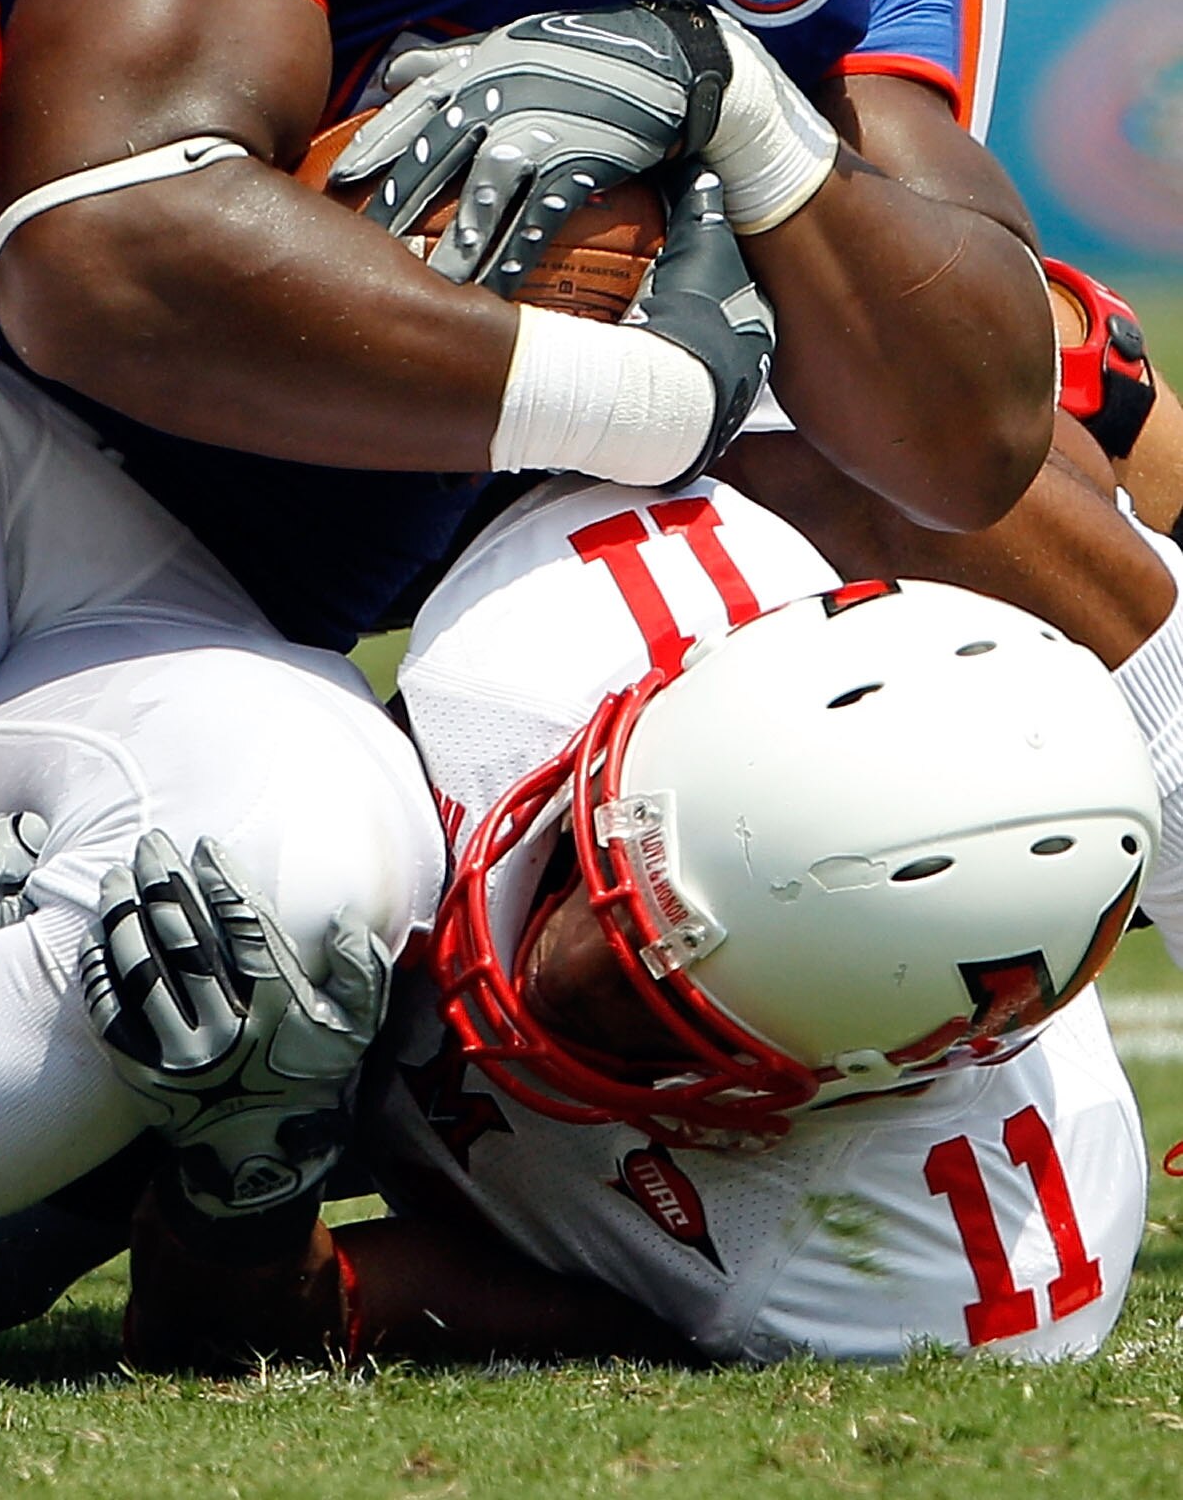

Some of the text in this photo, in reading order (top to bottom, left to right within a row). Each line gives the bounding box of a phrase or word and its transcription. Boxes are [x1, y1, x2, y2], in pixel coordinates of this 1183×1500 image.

[568, 495, 761, 683] 11
[652, 878, 690, 928] HONOR
[633, 1160, 690, 1231] MAC
[923, 1104, 1104, 1348] 11
